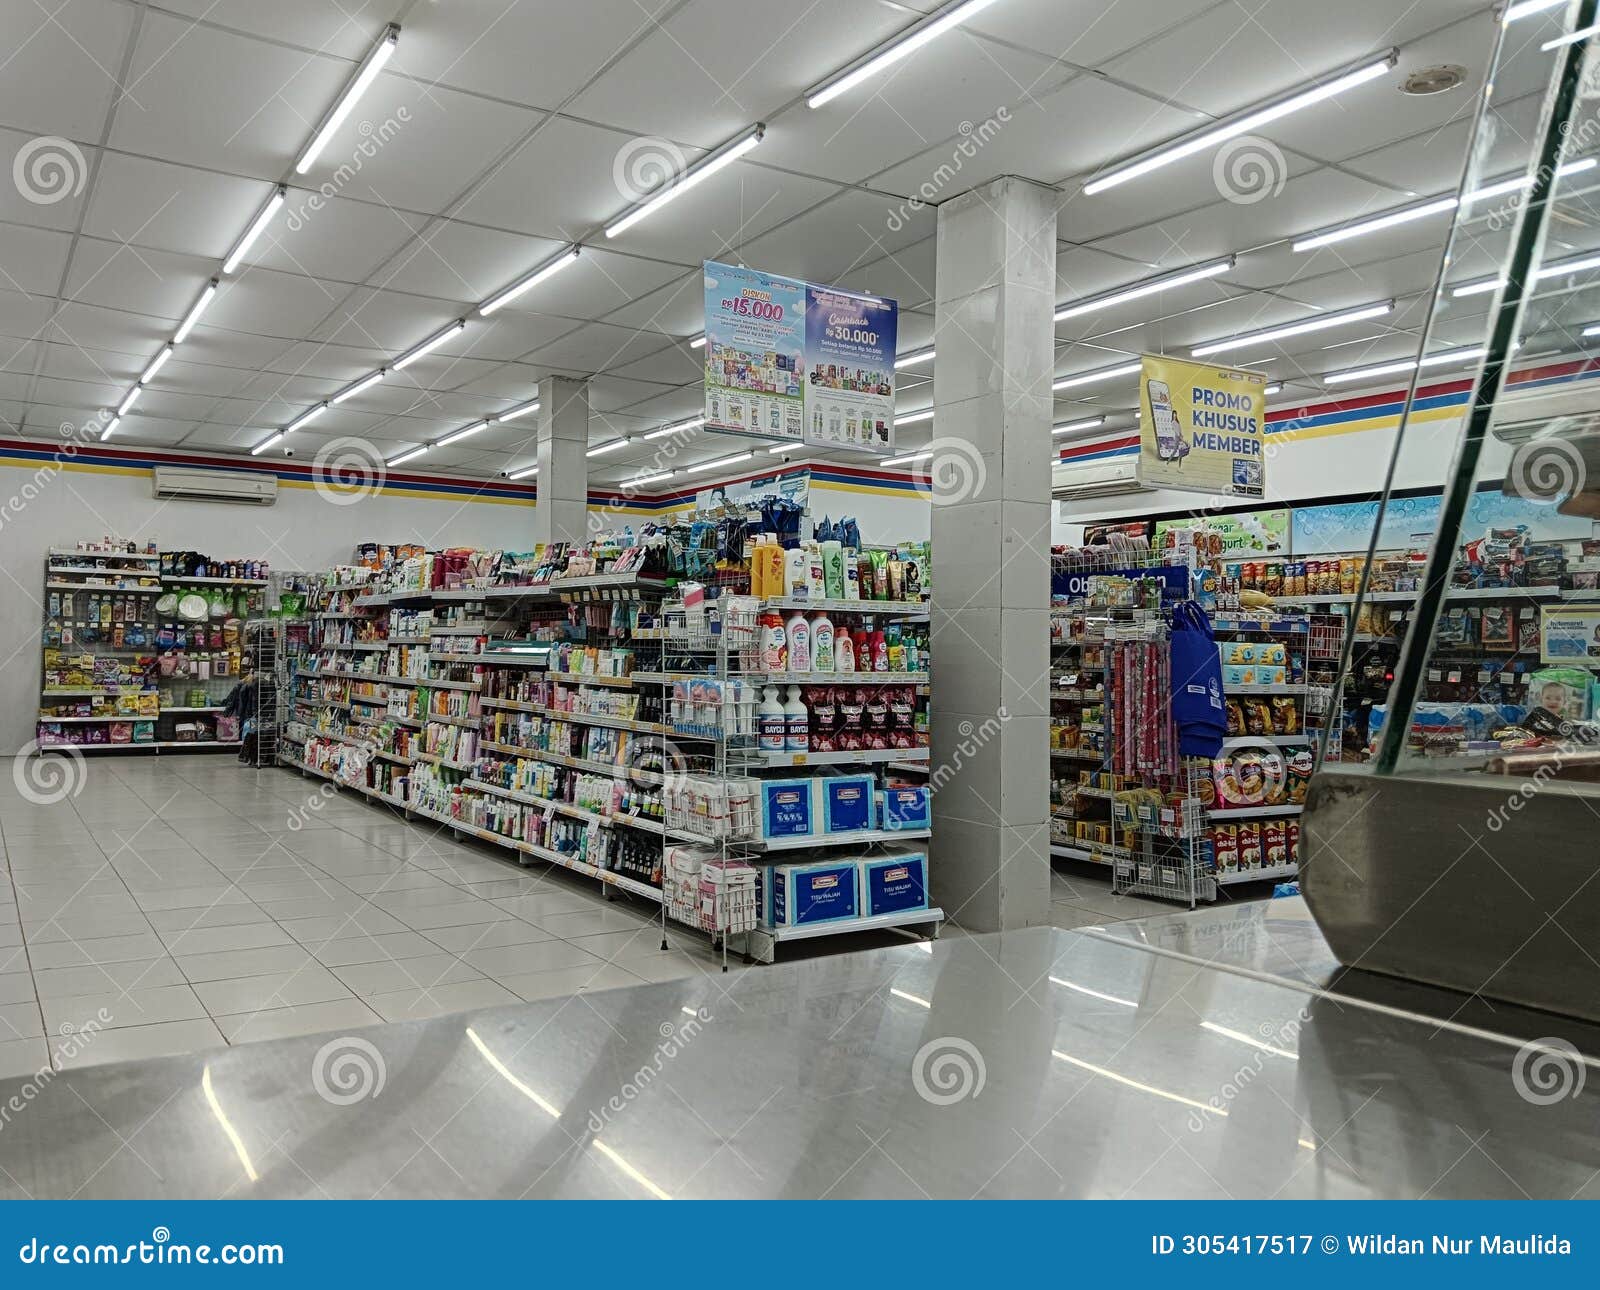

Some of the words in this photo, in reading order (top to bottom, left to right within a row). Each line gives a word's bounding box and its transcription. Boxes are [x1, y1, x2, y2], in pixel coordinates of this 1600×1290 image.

[742, 288, 771, 300] DISKON
[732, 297, 783, 321] 15.000
[1192, 387, 1252, 412] PROMO
[1192, 410, 1257, 434] KHUSUS
[1192, 431, 1261, 456] MEMBER
